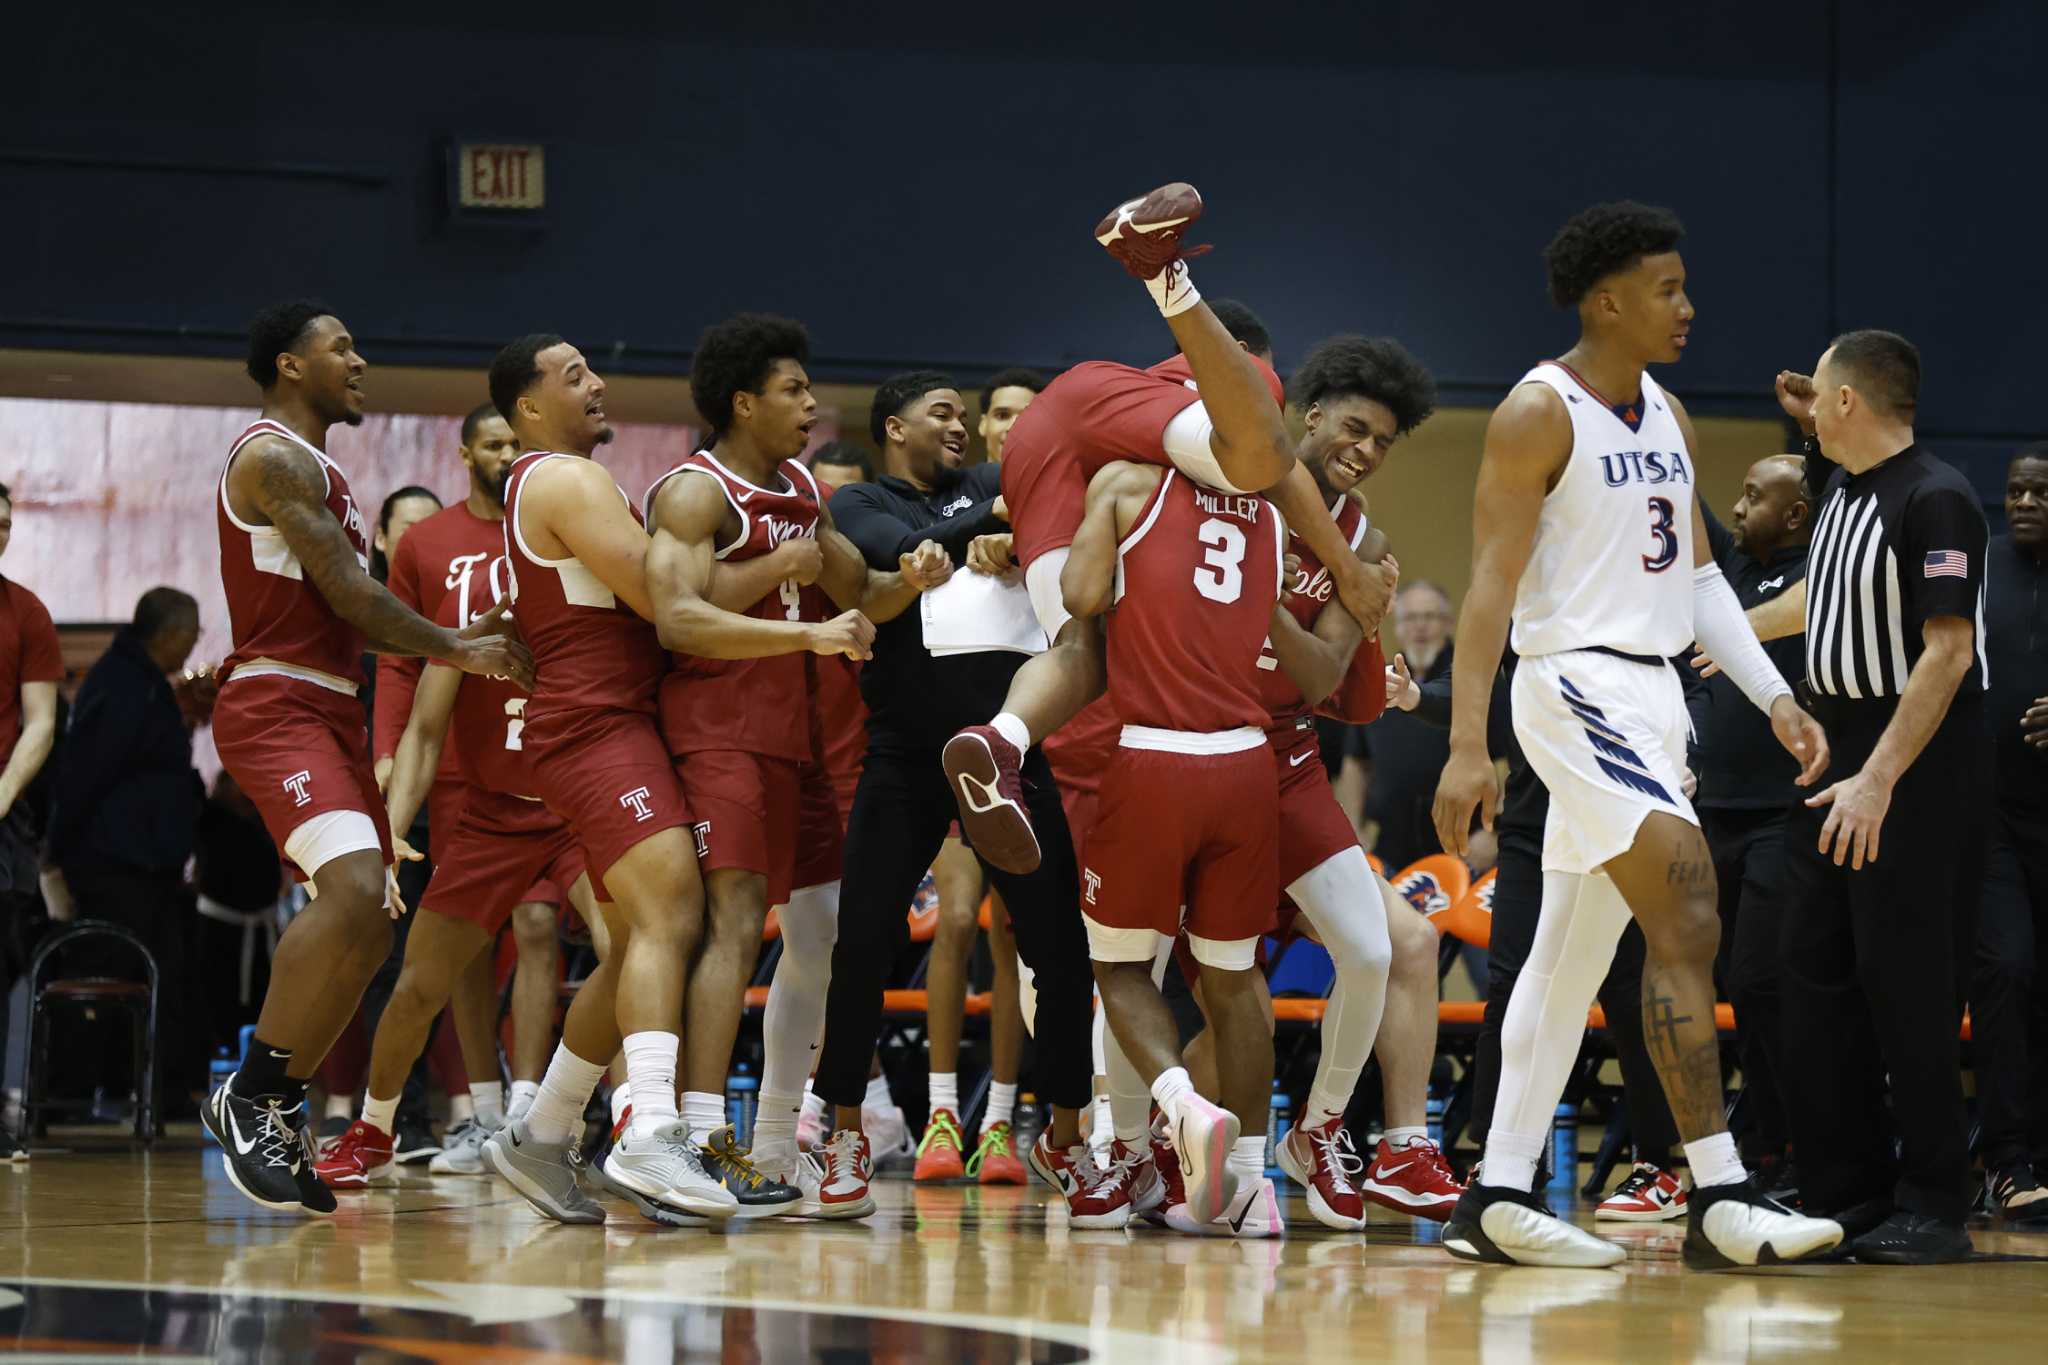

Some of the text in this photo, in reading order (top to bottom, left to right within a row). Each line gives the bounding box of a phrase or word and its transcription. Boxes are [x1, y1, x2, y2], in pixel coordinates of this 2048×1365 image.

[472, 148, 528, 198] EXIT
[1598, 451, 1689, 488] UTSA
[1195, 489, 1259, 524] MILLER
[1641, 496, 1678, 573] 3
[1194, 517, 1246, 604] 3
[283, 770, 311, 807] T
[620, 786, 654, 822] T
[1085, 867, 1101, 905] T
